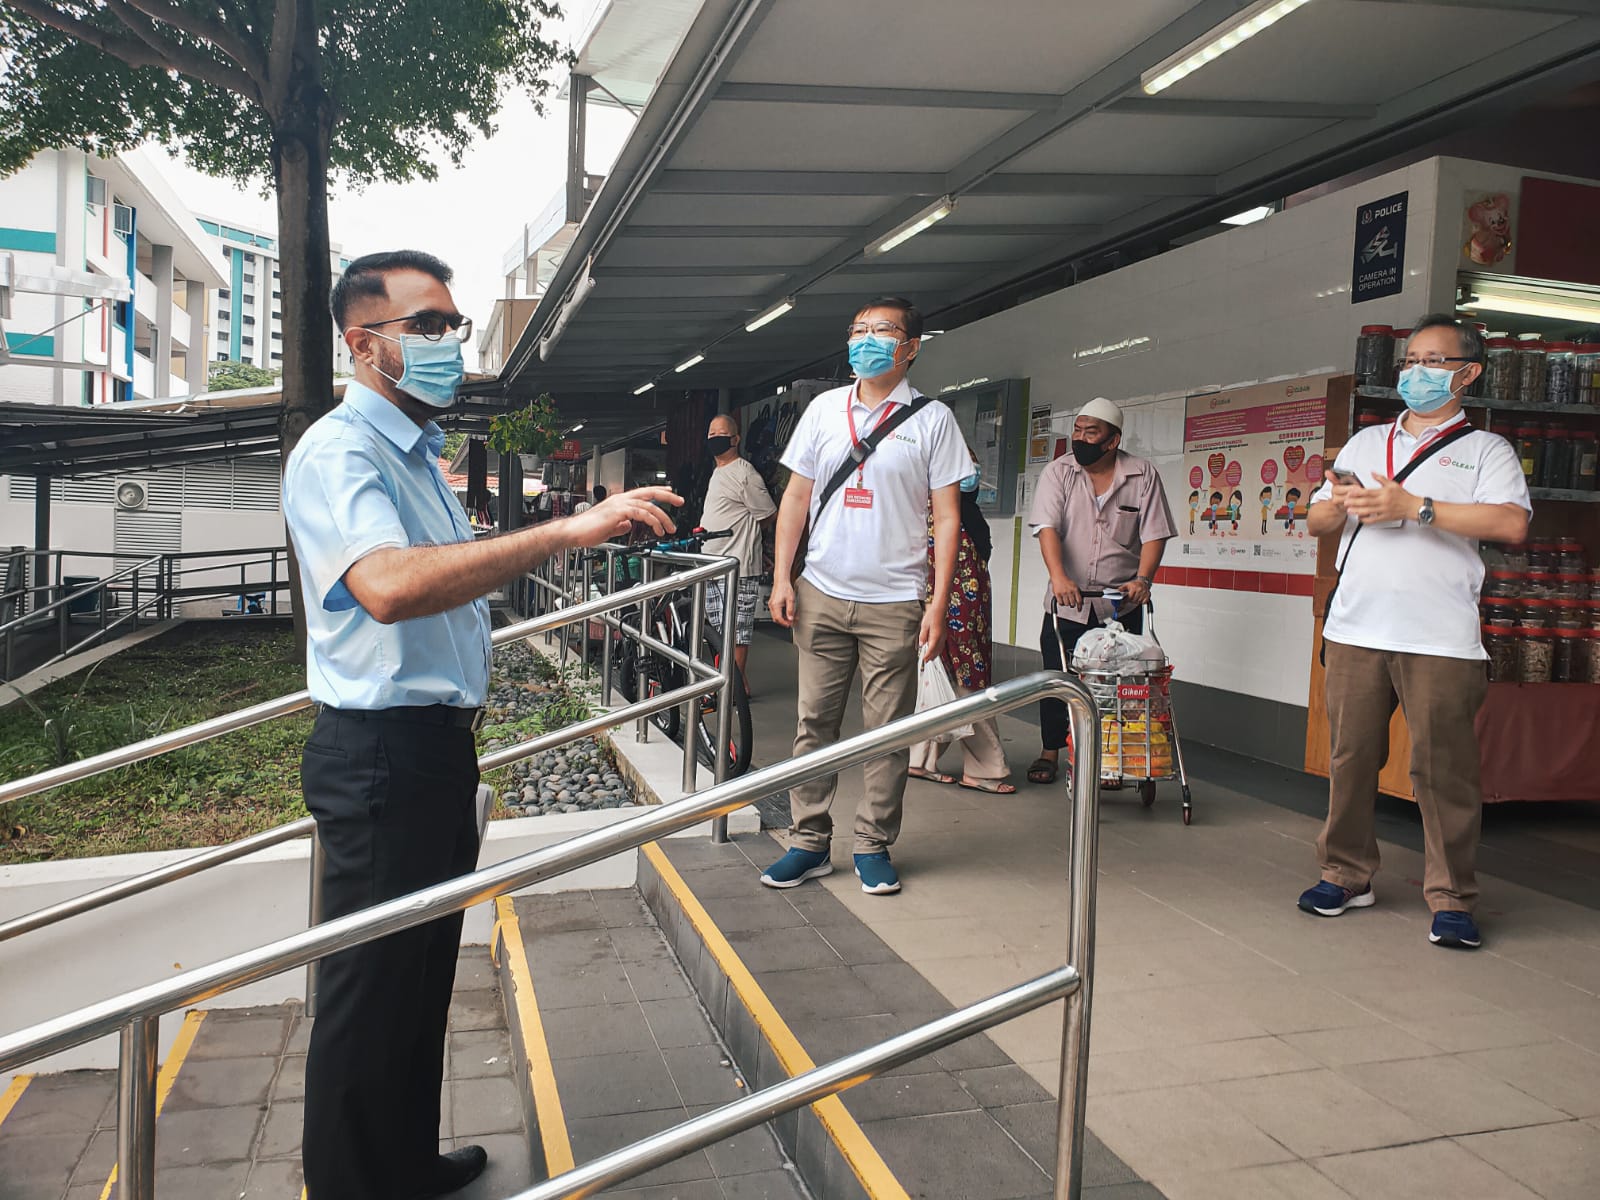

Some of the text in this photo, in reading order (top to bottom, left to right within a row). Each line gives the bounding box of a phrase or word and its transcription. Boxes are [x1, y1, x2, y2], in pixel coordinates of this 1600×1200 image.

[1374, 202, 1403, 220] POLICE
[1358, 266, 1397, 283] CAMERA IN
[1358, 276, 1396, 292] OPERATION
[895, 434, 917, 444] CLEAN
[1451, 460, 1475, 470] CLEAN
